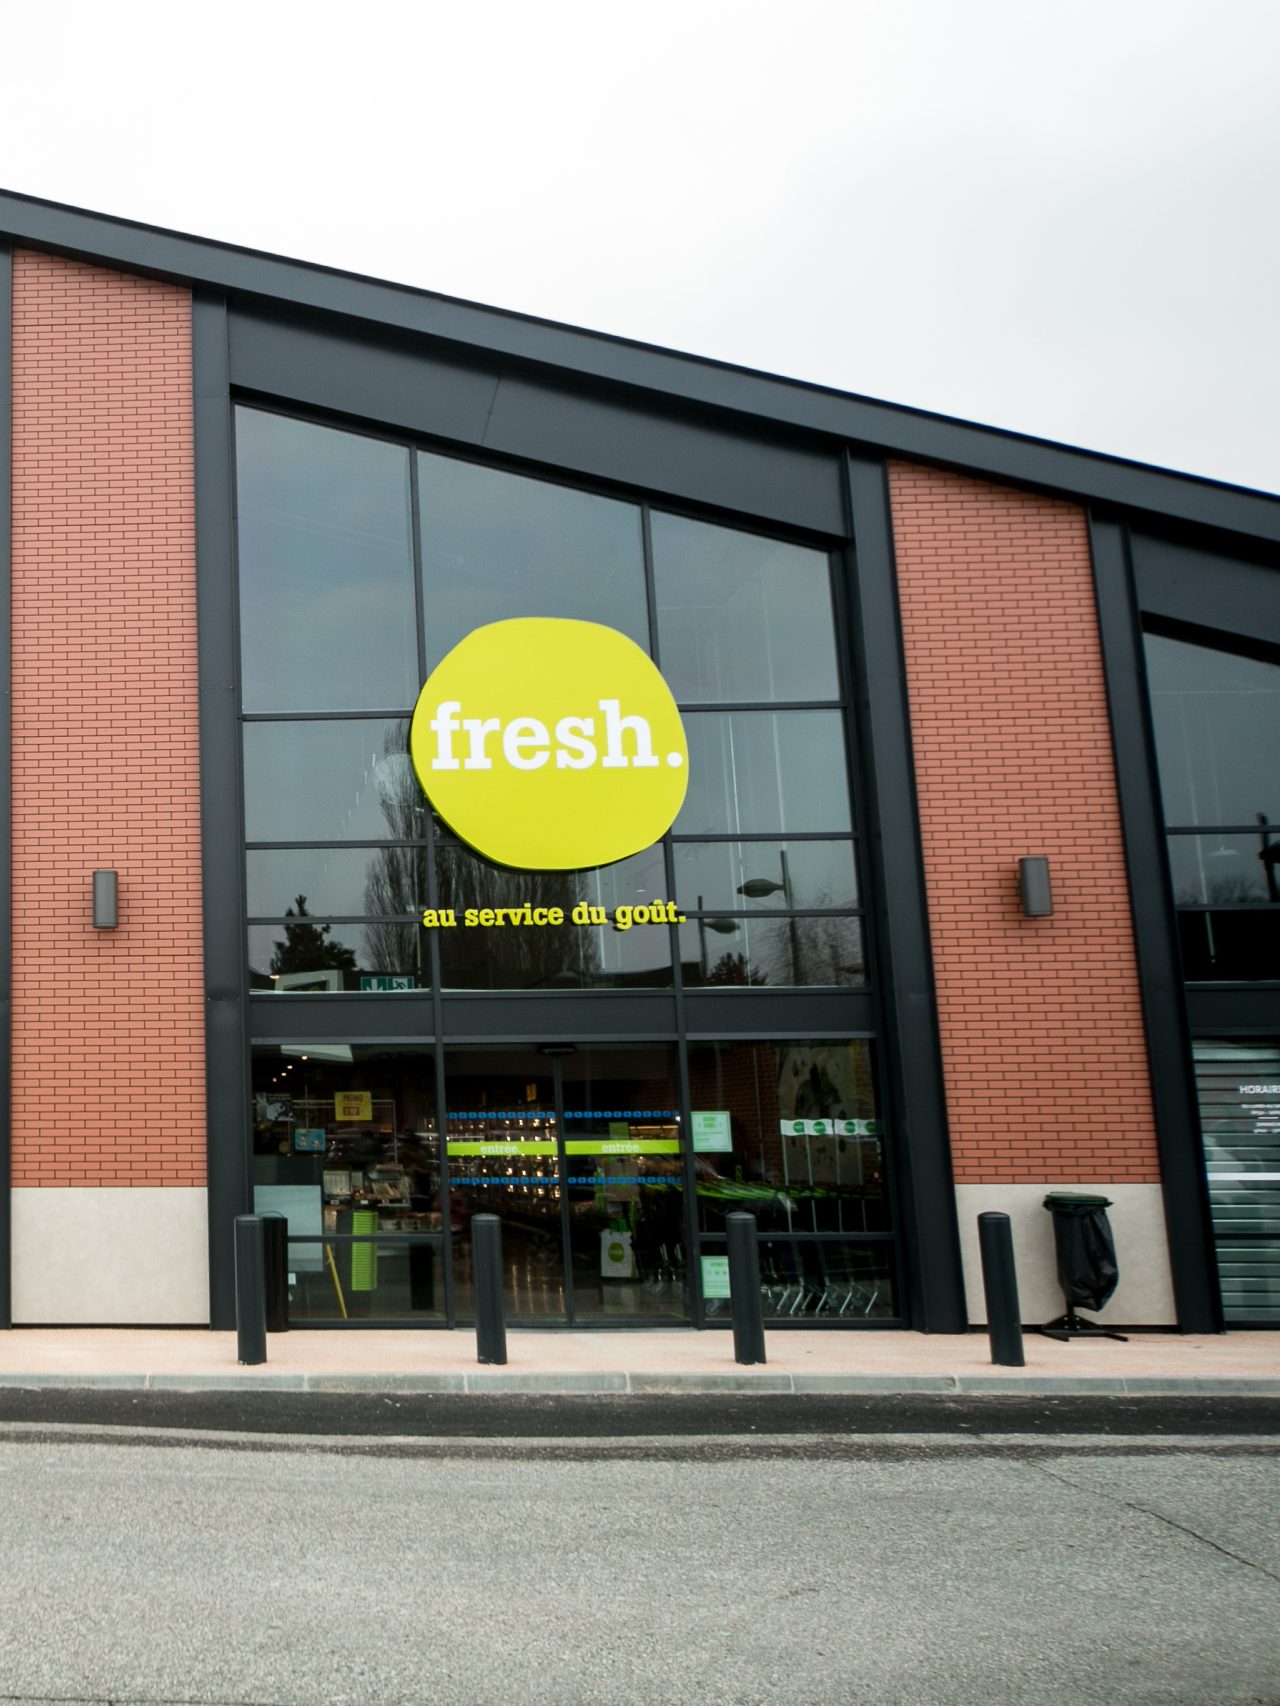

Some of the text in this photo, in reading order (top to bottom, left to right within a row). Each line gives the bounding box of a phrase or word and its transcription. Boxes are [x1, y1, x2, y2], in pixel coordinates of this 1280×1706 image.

[429, 698, 684, 771] fresh.
[423, 899, 687, 930] au service du goût.
